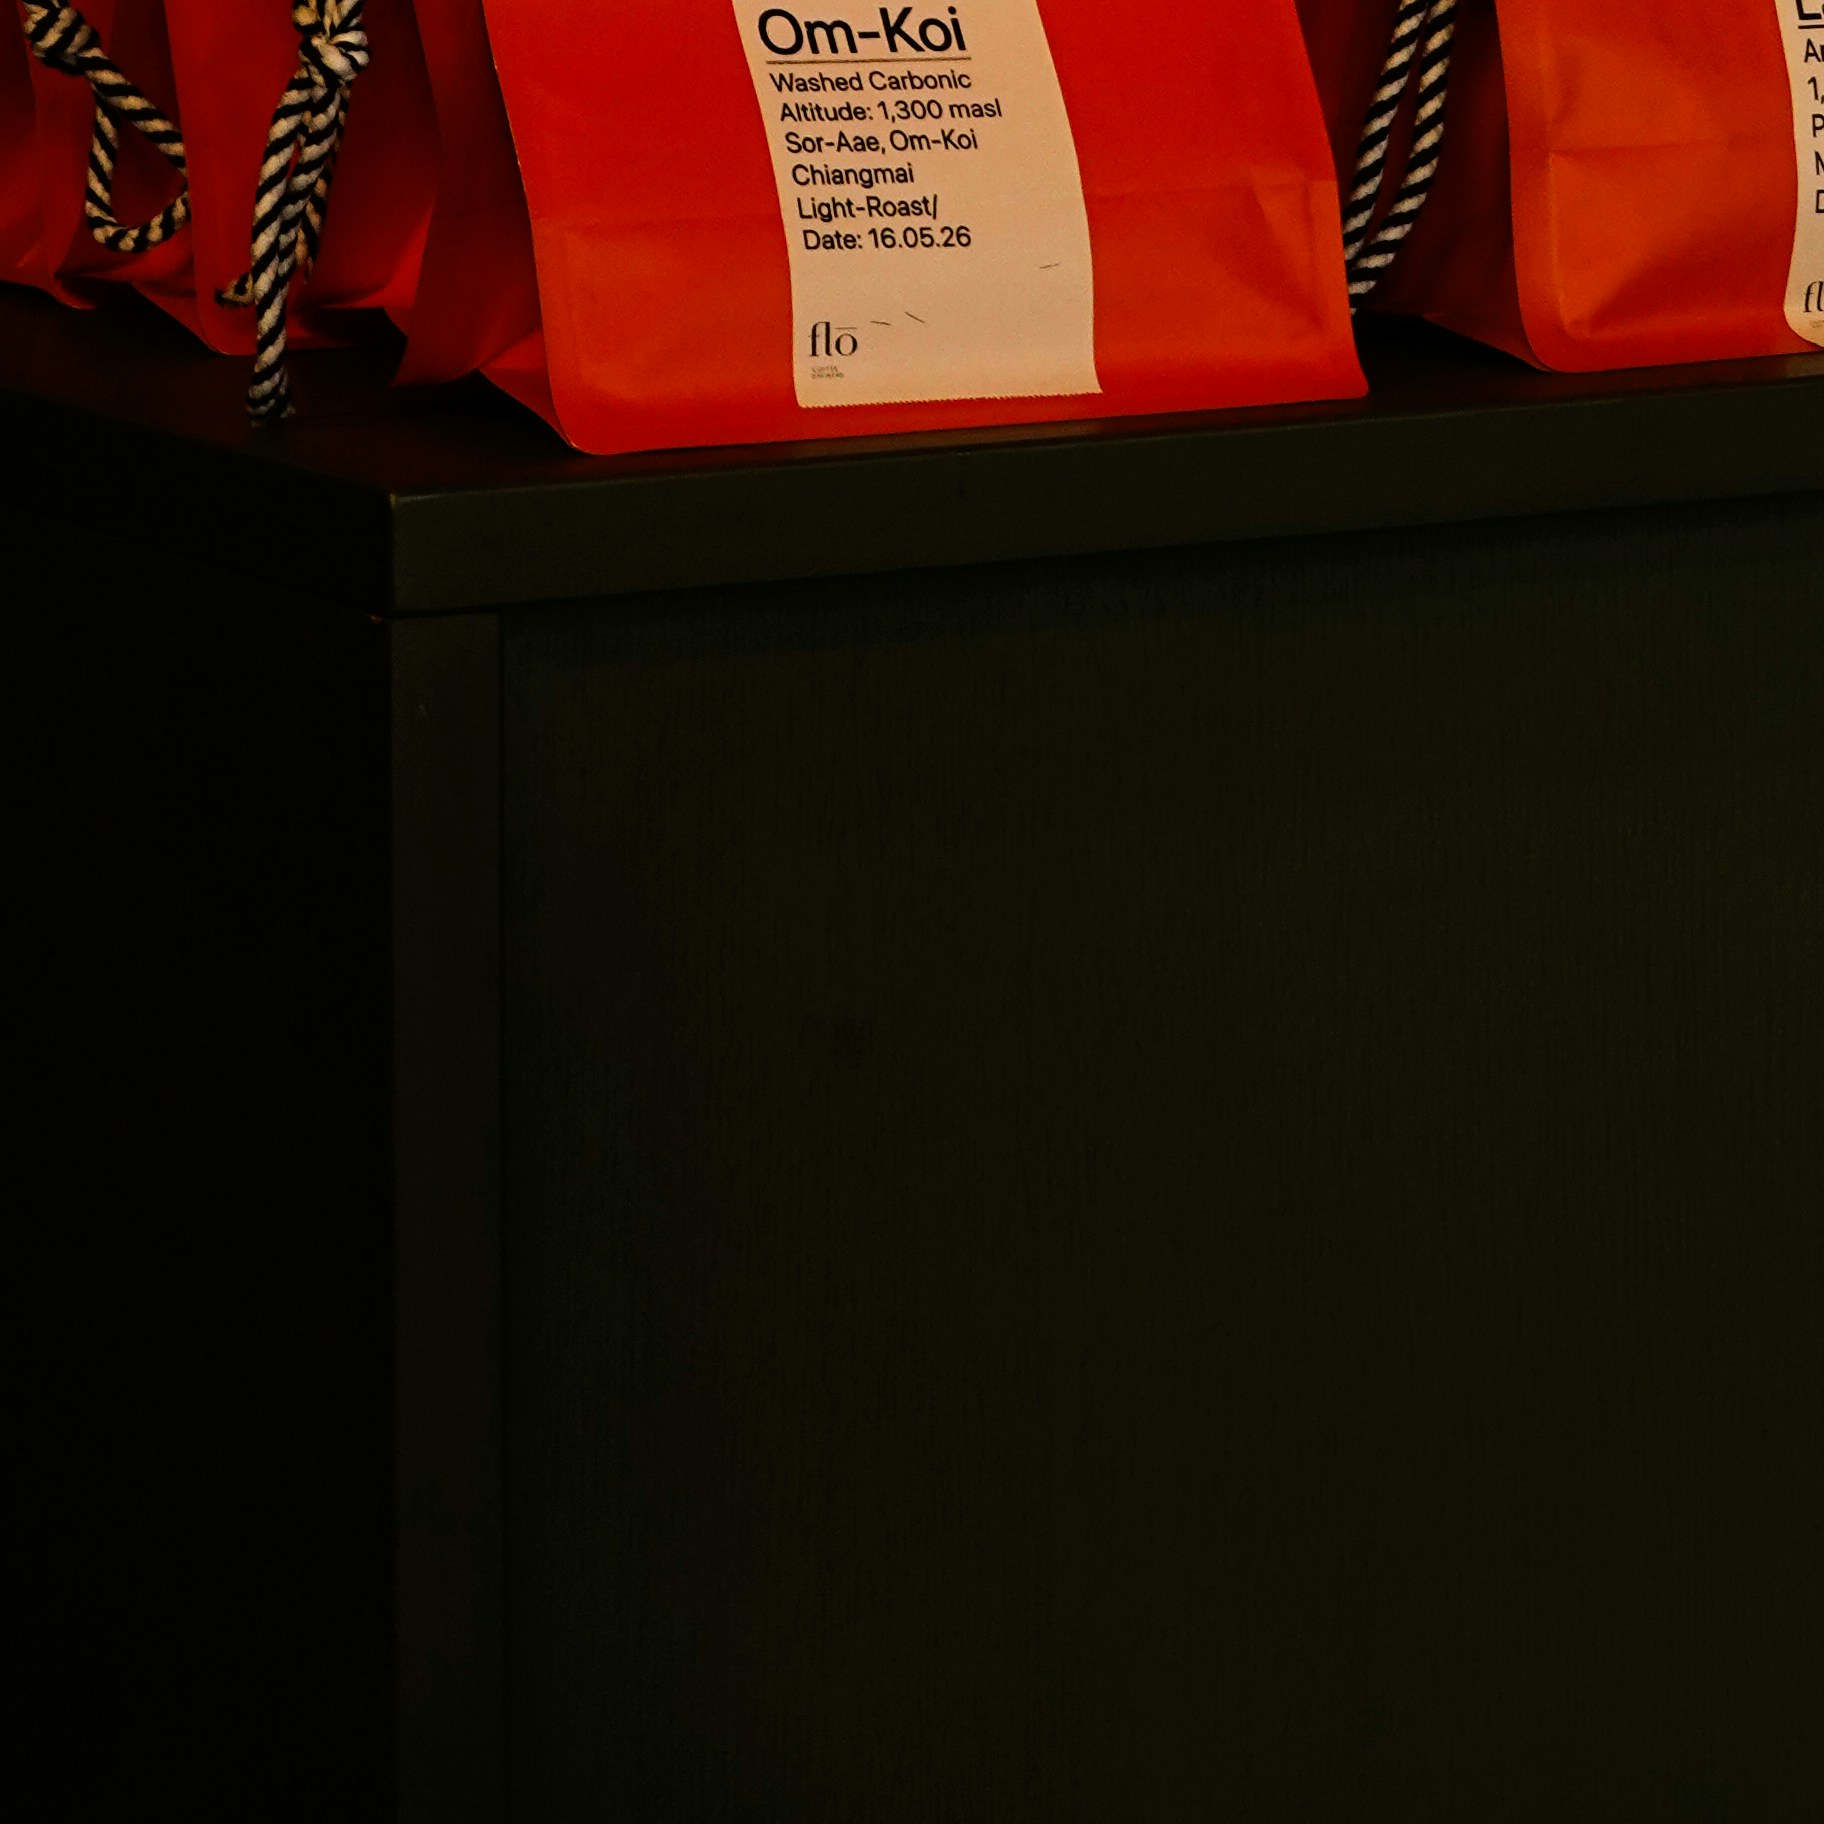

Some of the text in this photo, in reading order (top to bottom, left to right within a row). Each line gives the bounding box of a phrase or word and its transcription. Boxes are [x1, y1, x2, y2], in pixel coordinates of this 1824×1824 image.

[758, 6, 966, 55] Om-Koi
[769, 69, 971, 92] Washed Carbonic
[781, 98, 1002, 123] Altitude: 1,300 masl
[785, 129, 977, 154] Sor-Aae, Om-Koi
[792, 162, 914, 189] Chiangmai
[797, 194, 937, 222] Light-Roast/
[803, 226, 971, 250] Date: 16.05.26
